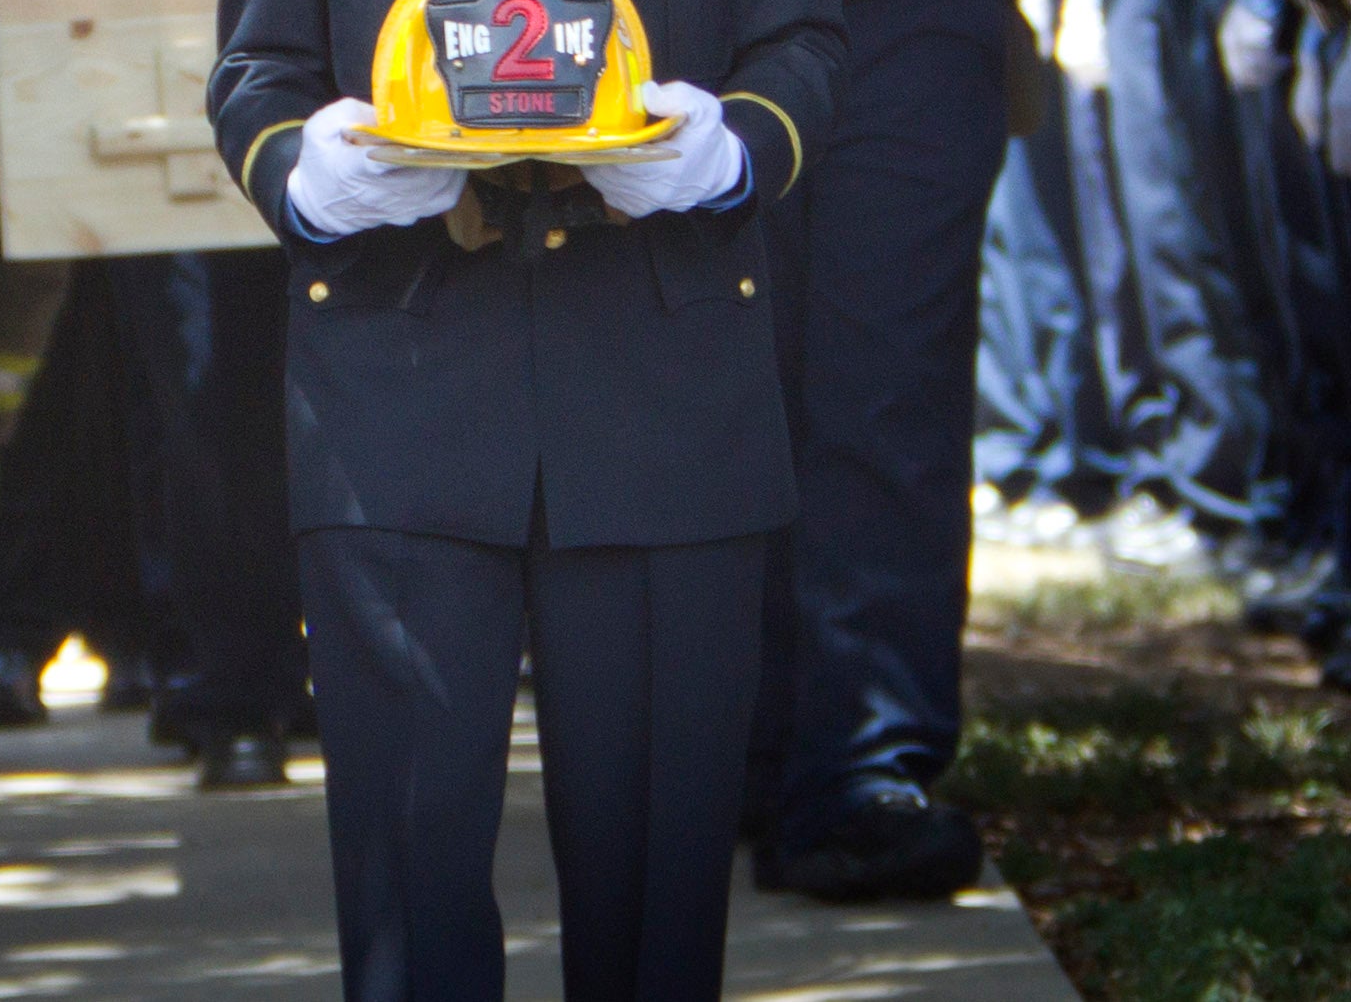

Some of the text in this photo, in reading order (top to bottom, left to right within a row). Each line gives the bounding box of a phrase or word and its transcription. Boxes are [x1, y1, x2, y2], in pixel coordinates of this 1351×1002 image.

[443, 19, 491, 60] ENG
[554, 18, 595, 60] INE
[489, 91, 555, 114] STONE
